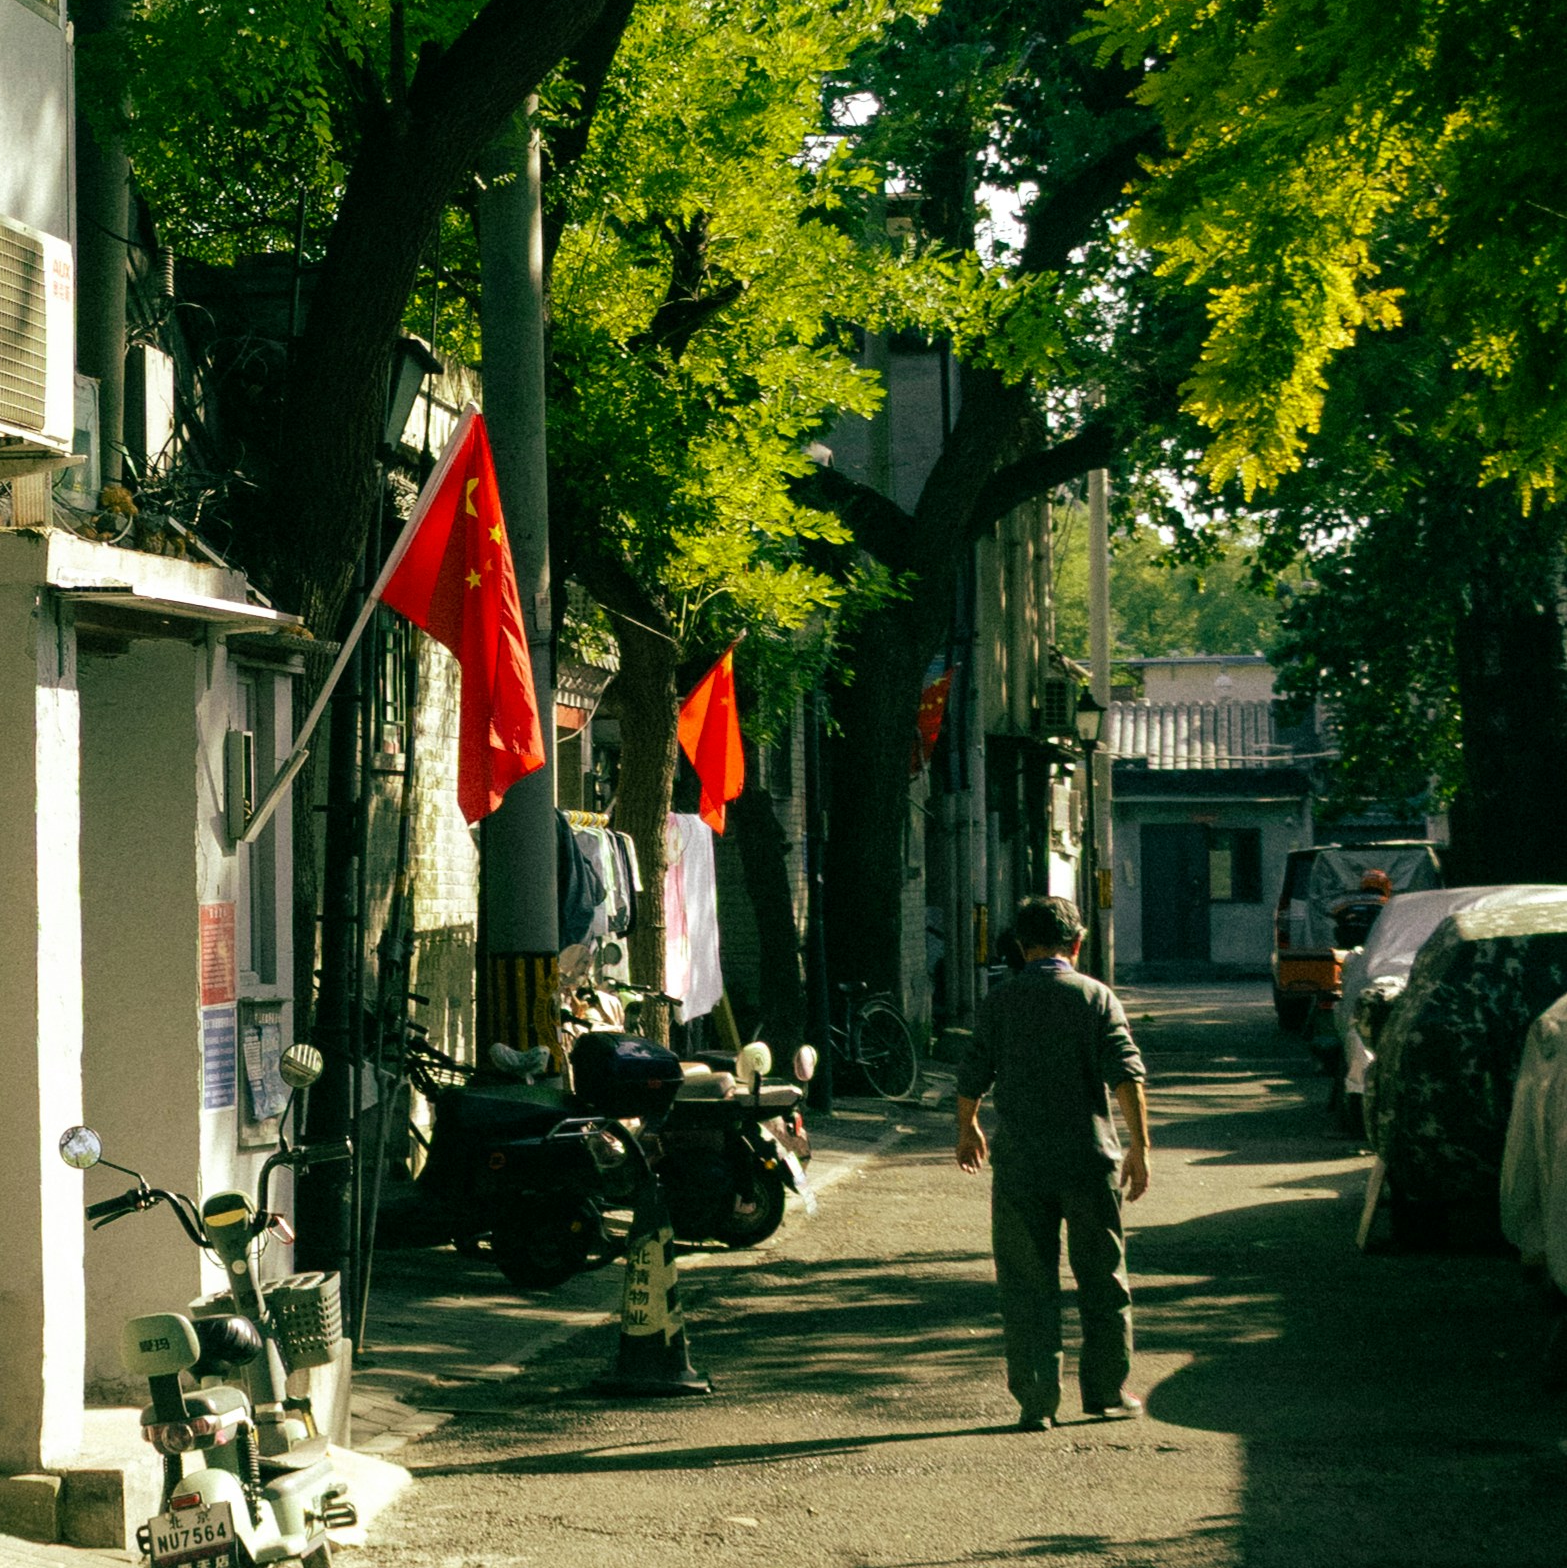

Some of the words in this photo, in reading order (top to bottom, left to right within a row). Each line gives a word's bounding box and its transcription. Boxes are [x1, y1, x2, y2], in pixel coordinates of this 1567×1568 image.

[52, 258, 71, 281] AUX
[169, 1511, 210, 1530] 北京
[157, 1522, 227, 1553] NU7564
